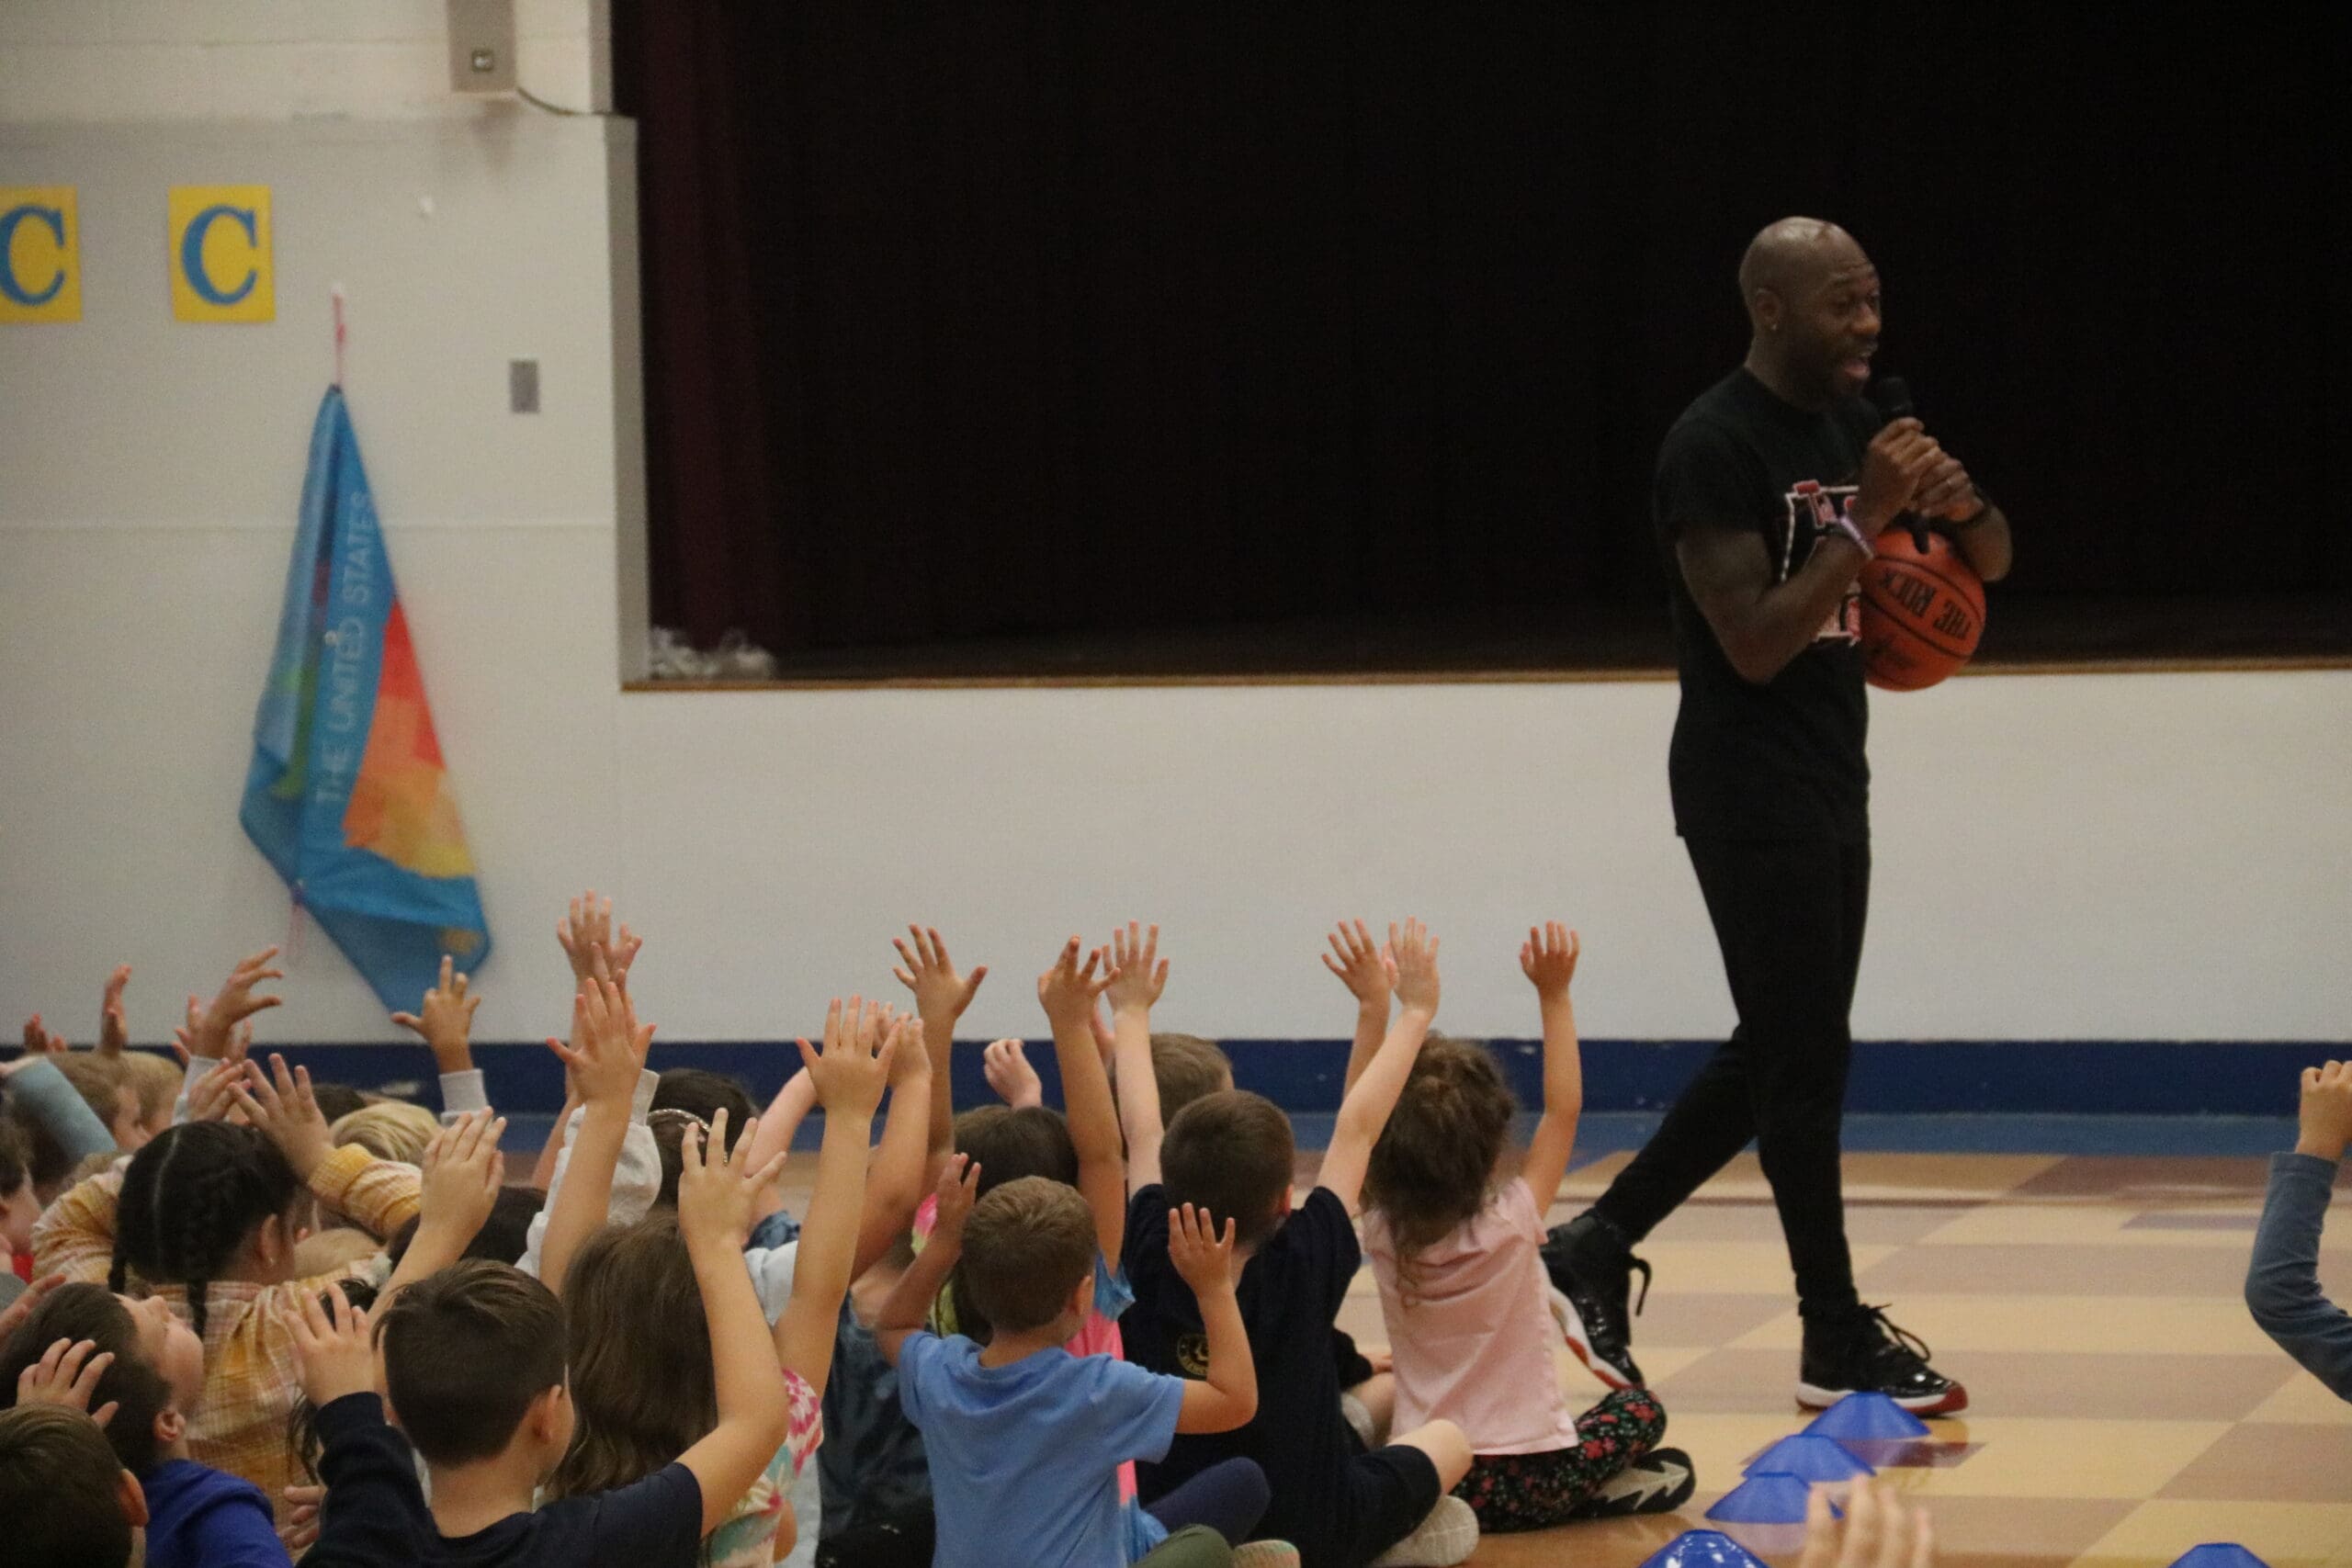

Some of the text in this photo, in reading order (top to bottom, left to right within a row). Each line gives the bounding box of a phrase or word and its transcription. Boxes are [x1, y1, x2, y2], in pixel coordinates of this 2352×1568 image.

[0, 204, 64, 306] C
[180, 204, 257, 306] C
[315, 491, 371, 803] THE UNITED STATES
[1933, 600, 1972, 640] THE
